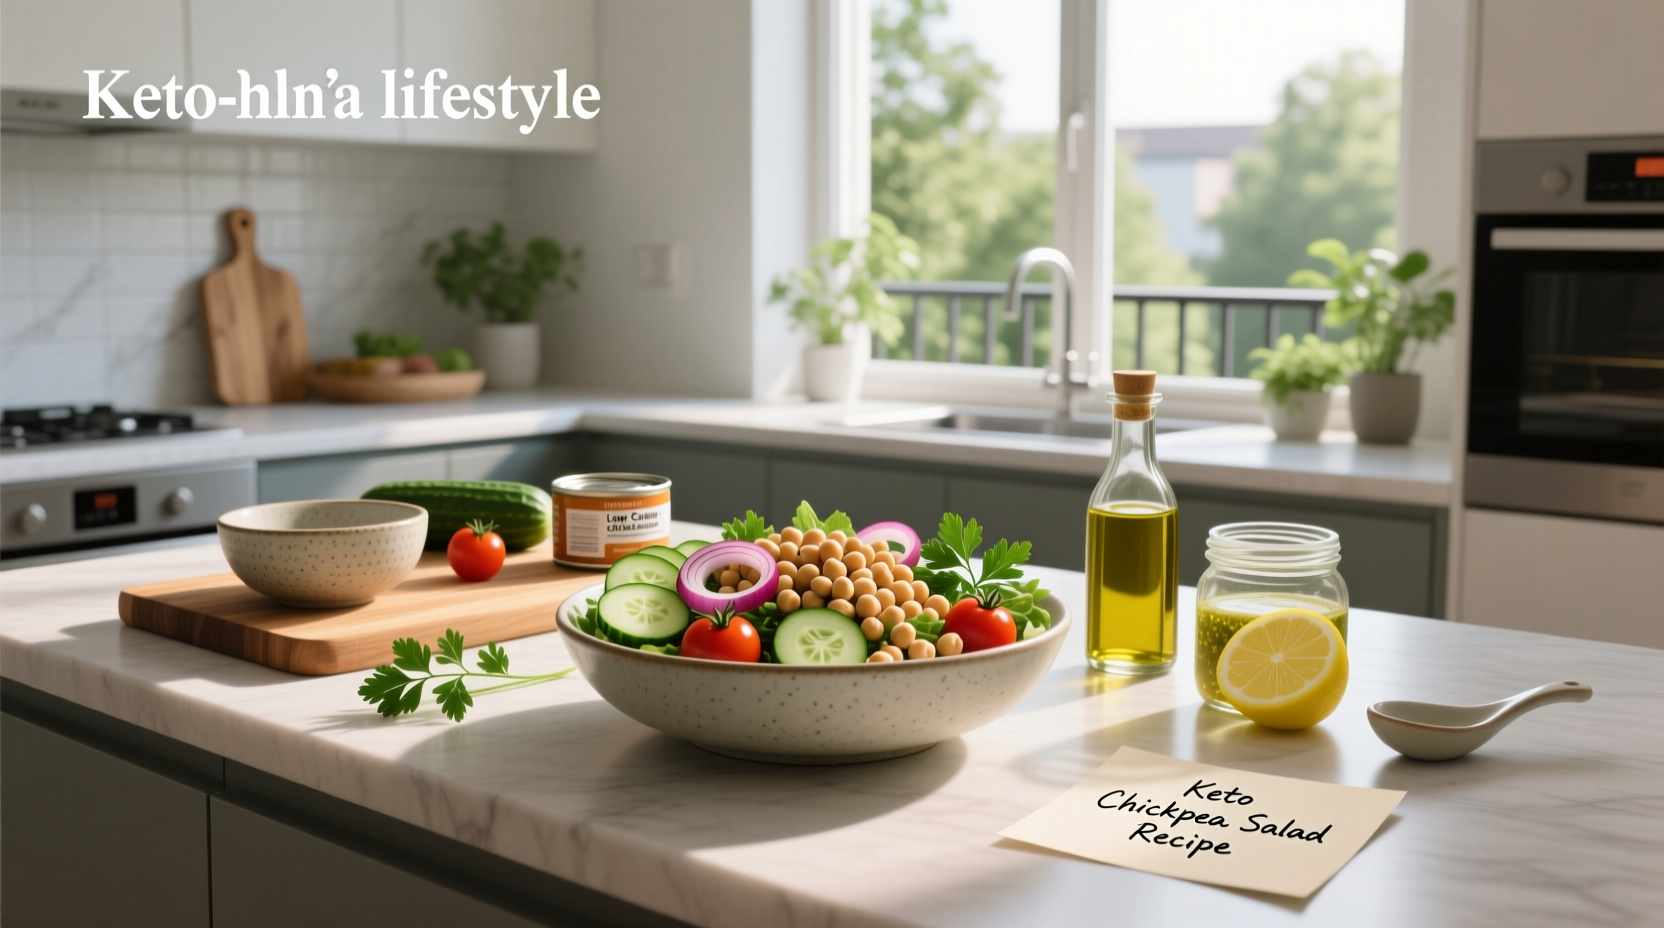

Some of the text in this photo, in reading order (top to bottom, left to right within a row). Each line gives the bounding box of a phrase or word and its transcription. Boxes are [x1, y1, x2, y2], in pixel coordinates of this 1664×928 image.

[1183, 779, 1254, 806] Keto
[1097, 790, 1333, 844] Chickpea Salad
[1128, 822, 1232, 859] Recipe
